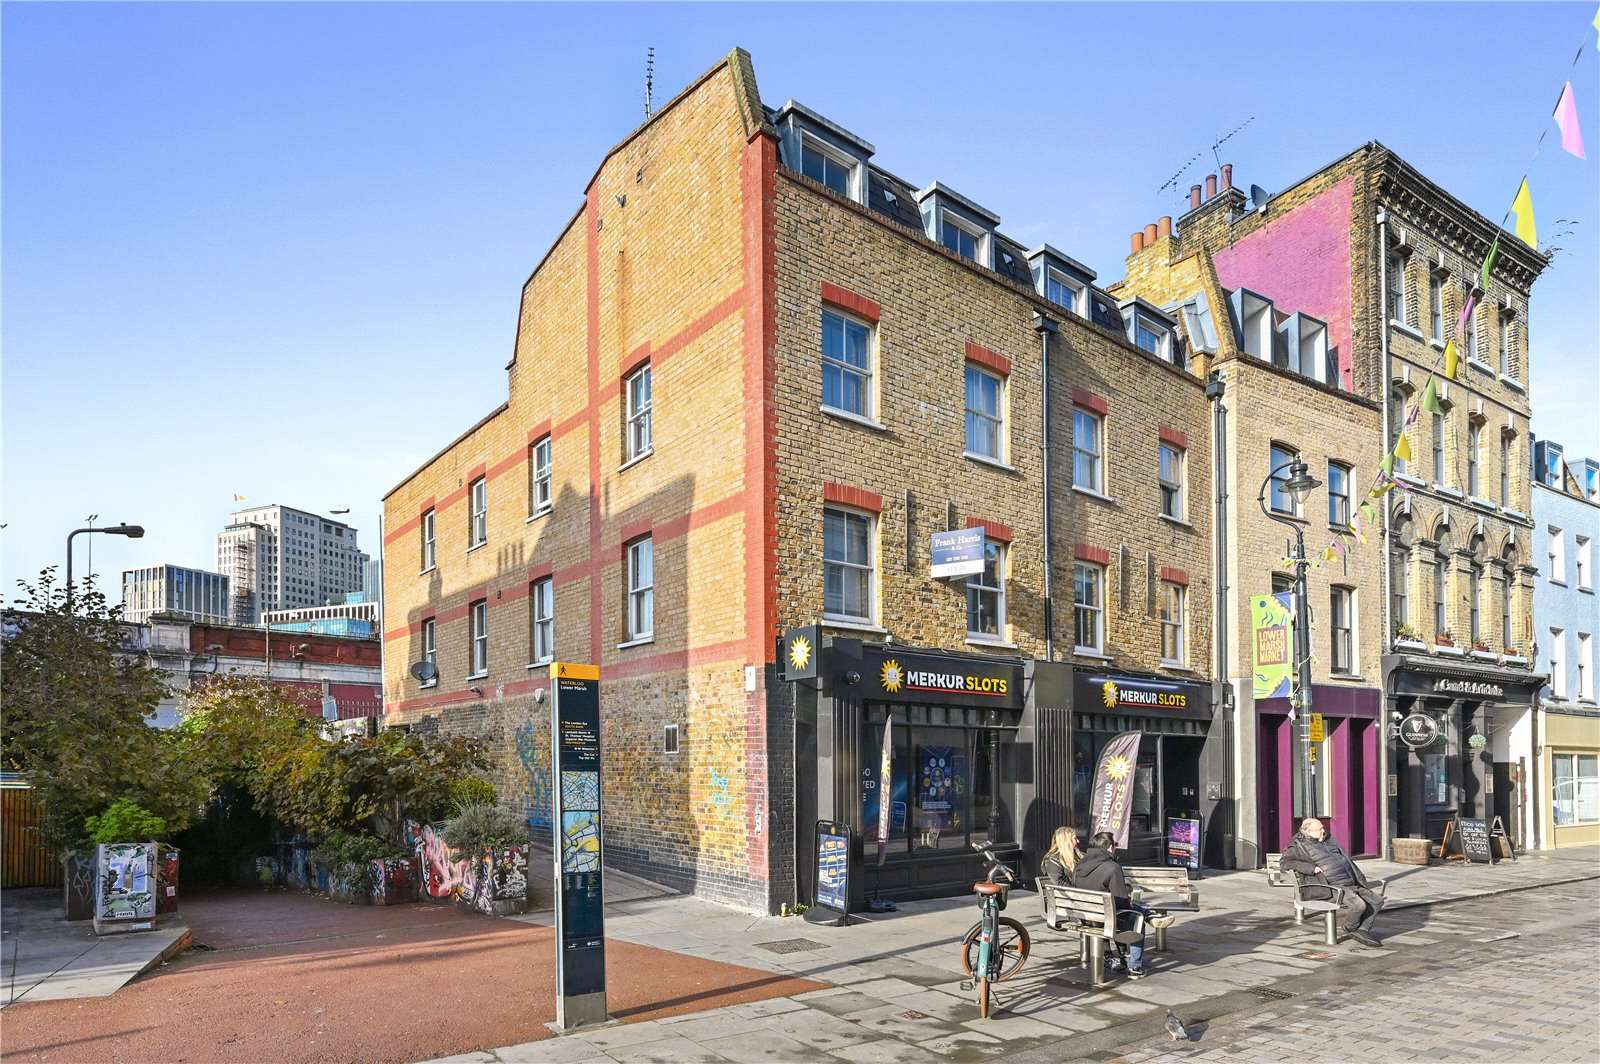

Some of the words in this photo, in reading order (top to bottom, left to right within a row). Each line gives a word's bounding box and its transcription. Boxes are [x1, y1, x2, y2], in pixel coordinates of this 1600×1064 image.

[934, 538, 955, 548] Frank
[958, 534, 981, 544] Harris
[1259, 630, 1285, 641] LOWER
[1259, 640, 1286, 651] MARSH
[1259, 650, 1285, 662] MARKET
[906, 670, 964, 689] MERKUR
[966, 676, 1008, 693] SLOTS
[1120, 689, 1158, 705] MERKUR
[1158, 693, 1187, 707] SLOTS
[1100, 782, 1114, 828] MERKUR
[1111, 783, 1126, 830] SLOTS
